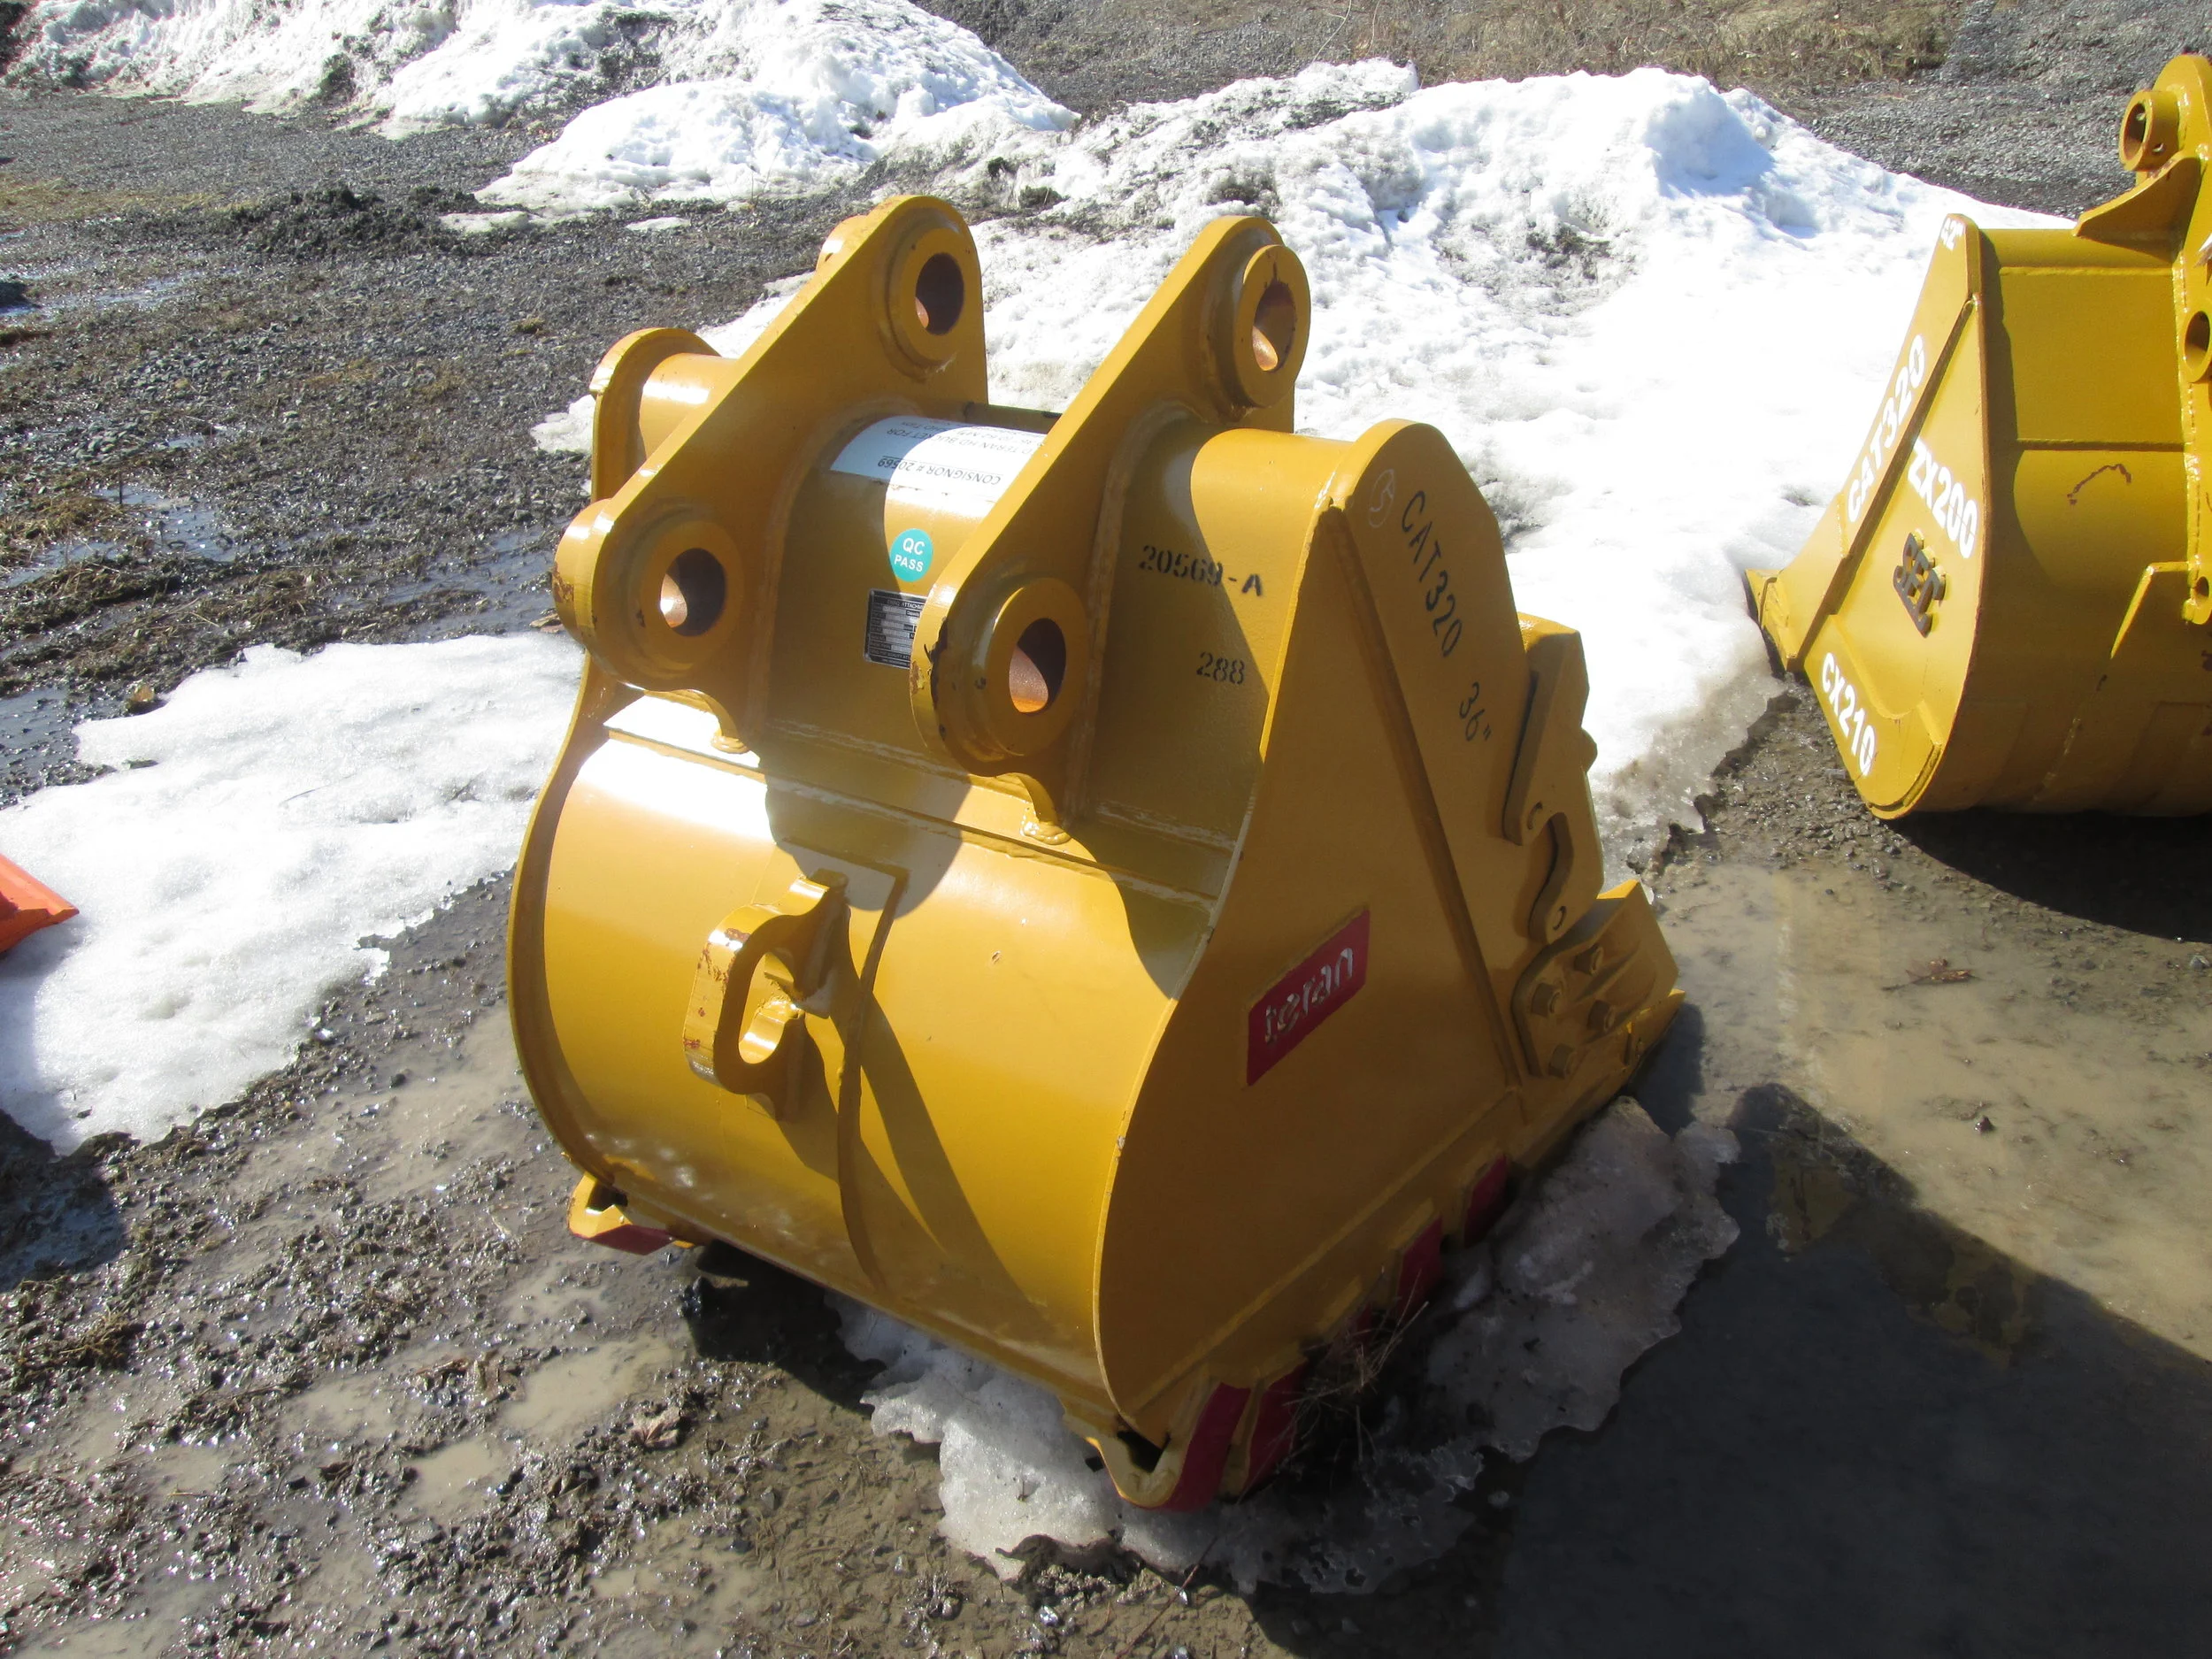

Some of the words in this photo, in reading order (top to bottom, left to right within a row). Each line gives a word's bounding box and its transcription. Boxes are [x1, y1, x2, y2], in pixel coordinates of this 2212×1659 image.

[1847, 334, 1925, 522] CAT320
[877, 456, 915, 472] 20569
[915, 463, 925, 472] #
[926, 465, 1002, 486] CONSIGNOR
[1908, 436, 1979, 559] ZX200
[894, 554, 925, 572] PASS
[902, 537, 926, 556] QC
[1139, 545, 1263, 597] 20569-A
[1402, 489, 1463, 657] CAT320
[1195, 651, 1246, 686] 288
[1822, 652, 1876, 777] CX210
